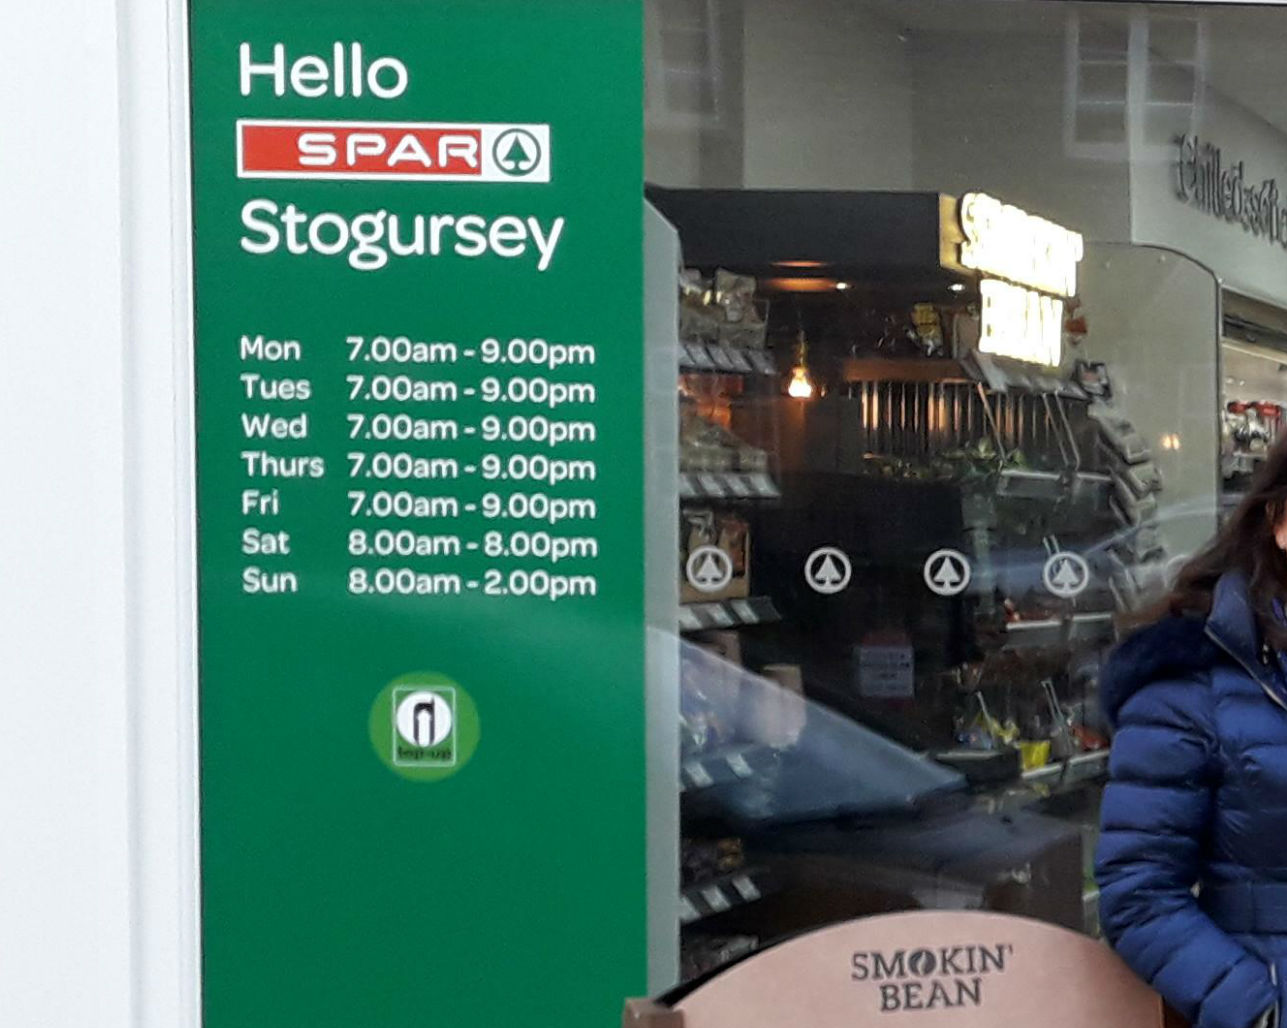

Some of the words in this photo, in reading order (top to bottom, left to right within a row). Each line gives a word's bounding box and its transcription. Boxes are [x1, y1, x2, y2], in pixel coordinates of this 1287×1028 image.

[240, 42, 407, 98] Hello
[298, 131, 479, 168] SPAR
[241, 200, 564, 271] Stogursey
[240, 335, 300, 362] Mon
[241, 375, 310, 401] Tues
[242, 413, 307, 440] Wed
[242, 451, 324, 478] Thurs
[242, 490, 279, 516] Fri
[242, 528, 289, 555] Sat
[243, 567, 297, 594] Sun
[852, 943, 1013, 981] SMOKIN'
[879, 978, 981, 1011] BEAN
